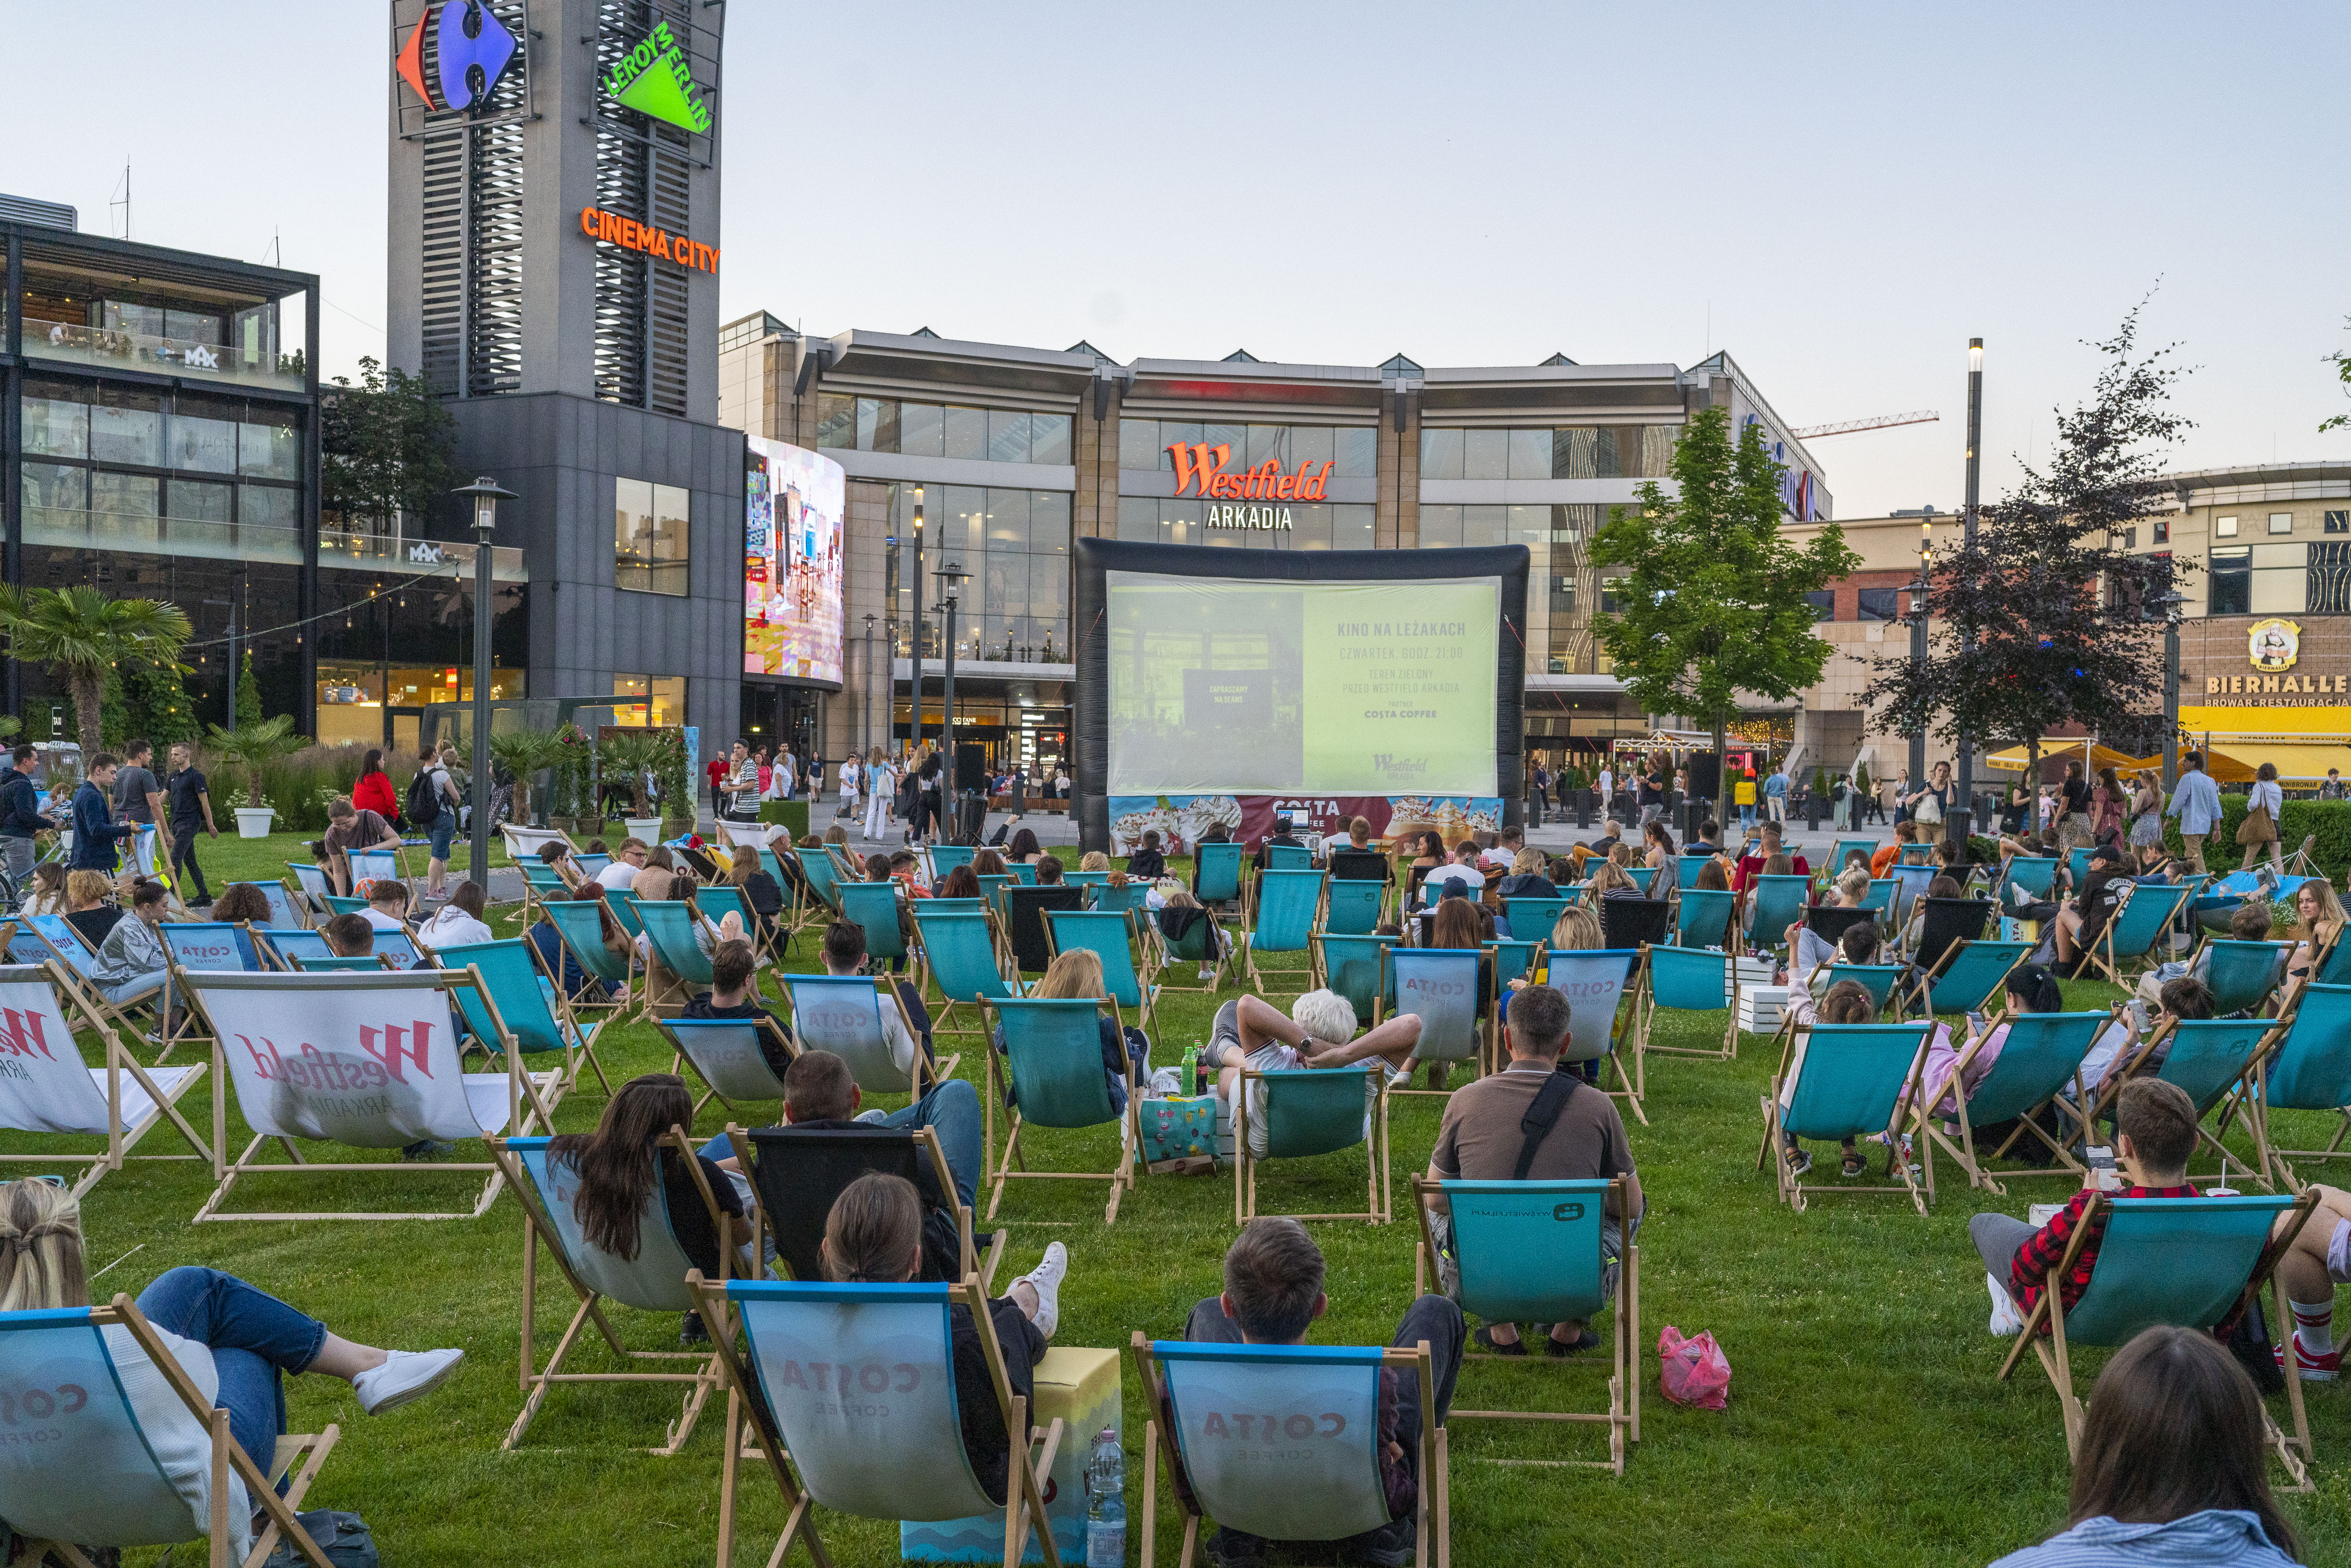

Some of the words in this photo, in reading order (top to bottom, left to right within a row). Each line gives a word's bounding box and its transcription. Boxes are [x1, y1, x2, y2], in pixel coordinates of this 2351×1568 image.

[602, 32, 659, 97] LEROY
[653, 21, 711, 133] MERLIN
[581, 207, 670, 260] CINEMA
[674, 236, 721, 274] CITY
[185, 345, 219, 369] MAX
[1167, 441, 1335, 501] Westfield
[1208, 505, 1293, 530] ARKADIA
[410, 542, 439, 563] MAX
[1338, 623, 1369, 636] KINO
[1374, 623, 1391, 636] NA
[1396, 621, 1465, 636] LEŻAKACH
[1340, 647, 1398, 660] CZWARTEK,
[1403, 647, 1432, 659] GODZ.
[1436, 647, 1463, 659] 21:00
[1369, 669, 1395, 679] TEREN
[1398, 669, 1433, 679] ZIELONY
[1343, 684, 1369, 693] PRZED
[1373, 683, 1418, 693] WESTFIELD
[1421, 683, 1460, 693] ARKADIA
[2207, 675, 2347, 694] BIERHALLE
[53, 717, 62, 725] TAXI
[1364, 710, 1397, 718] COSTA
[1373, 753, 1428, 772] Westfield
[52, 937, 75, 951] COSTA
